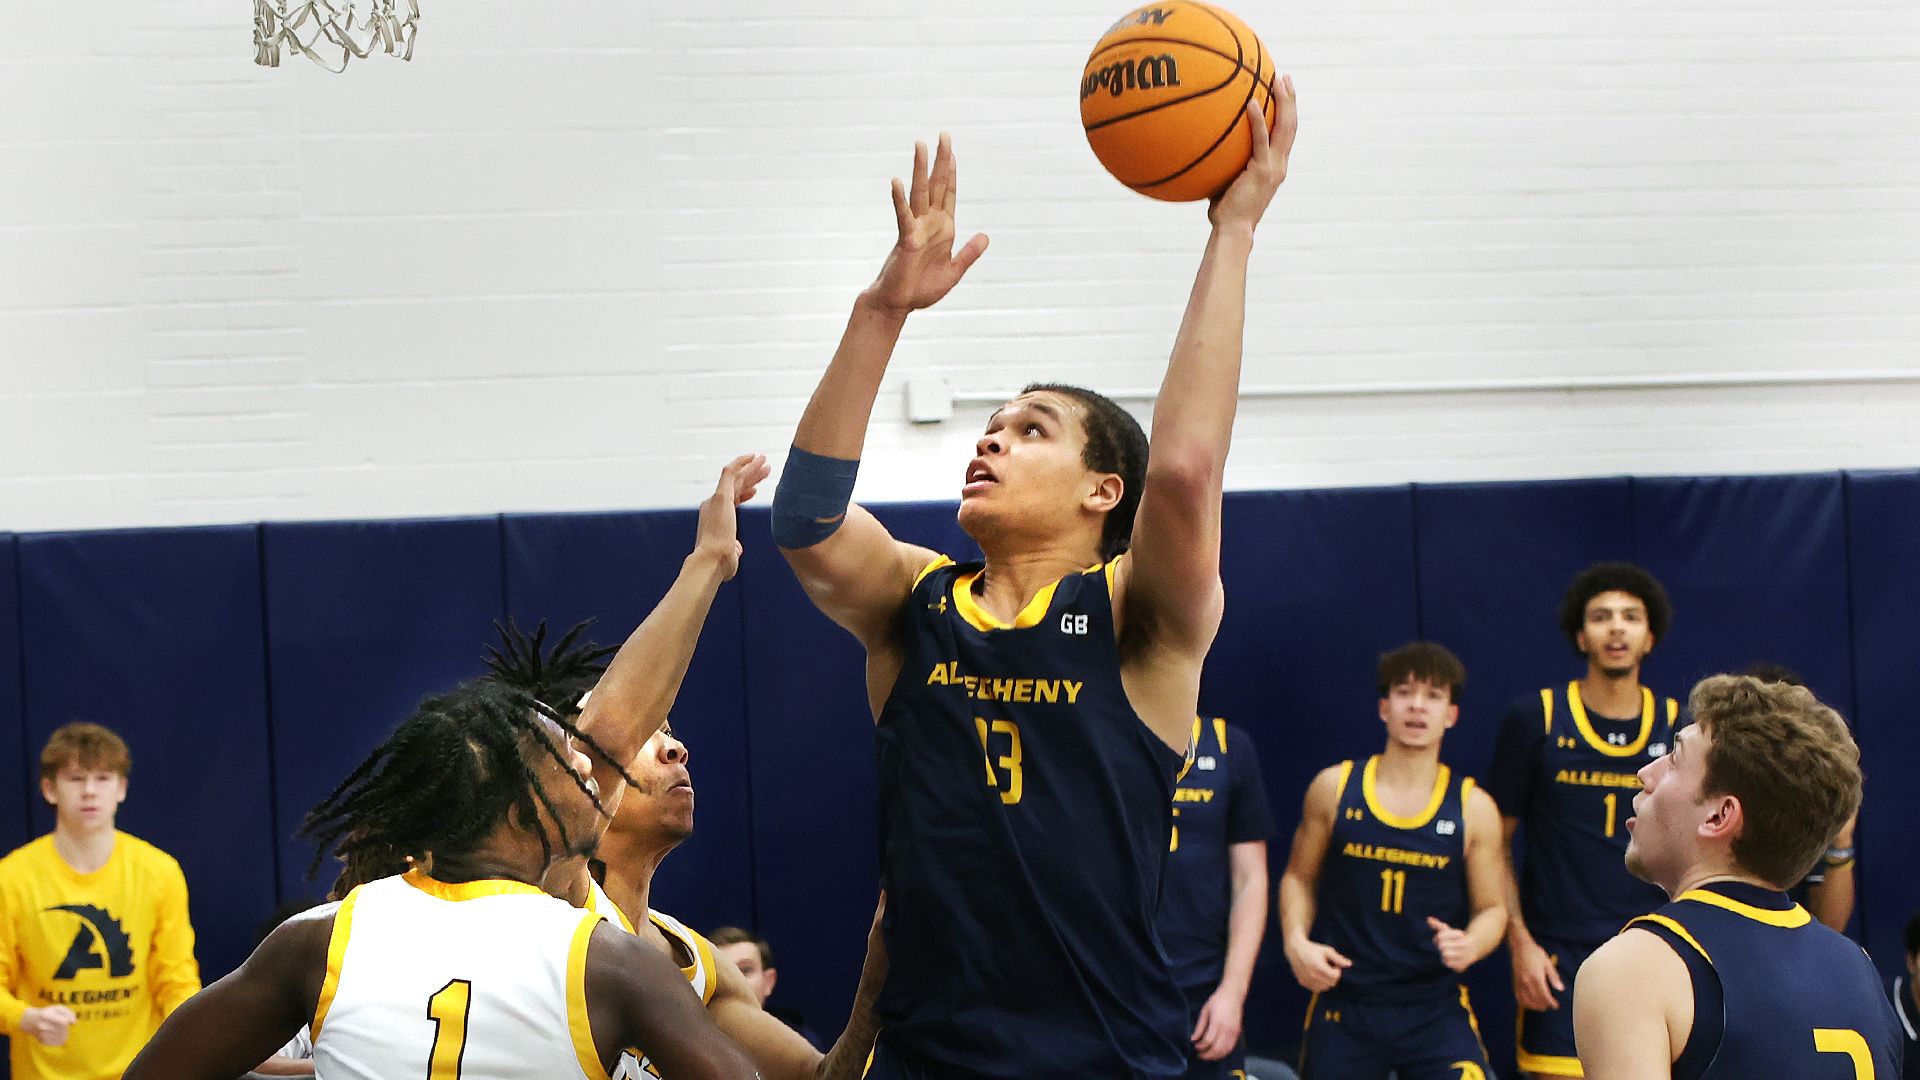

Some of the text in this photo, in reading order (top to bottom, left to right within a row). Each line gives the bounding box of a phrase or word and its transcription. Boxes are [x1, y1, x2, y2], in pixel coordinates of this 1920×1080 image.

[1061, 613, 1088, 634] GB
[926, 660, 1084, 704] ALEGHENY
[1555, 768, 1645, 790] ALLEGHE
[1603, 793, 1617, 838] 1
[1343, 842, 1451, 870] ALLEGHENY
[1380, 868, 1407, 914] 11
[426, 978, 471, 1080] 1
